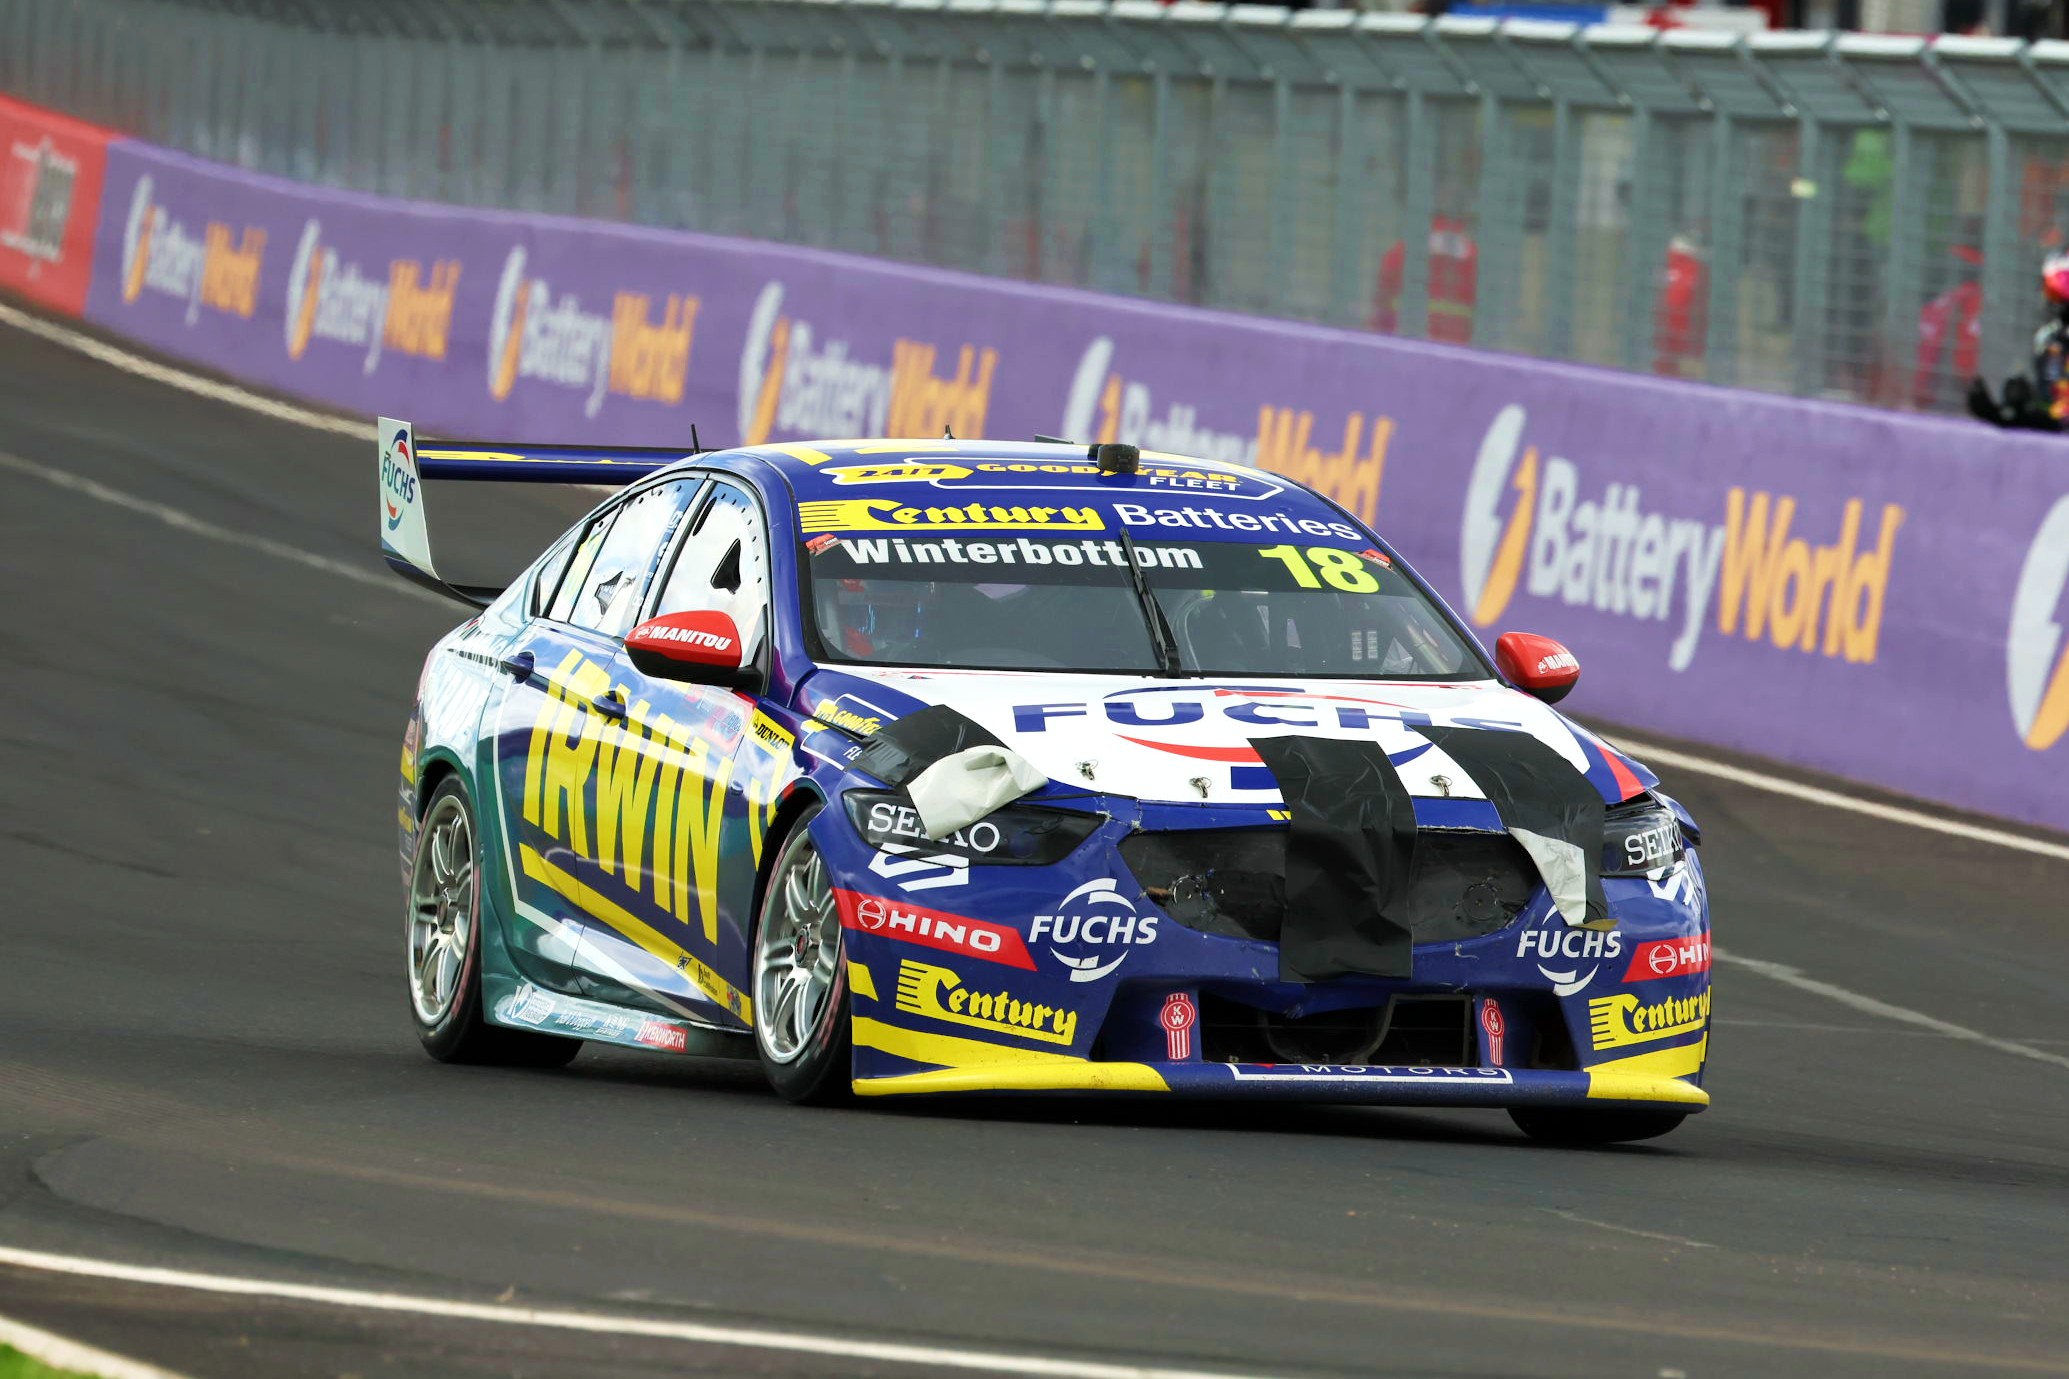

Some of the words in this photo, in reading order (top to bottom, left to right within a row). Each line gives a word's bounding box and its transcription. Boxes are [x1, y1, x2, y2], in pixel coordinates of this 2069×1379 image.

[381, 451, 416, 504] FUCHS
[1150, 476, 1240, 491] FLEET
[800, 499, 1105, 533] Century
[1112, 503, 1362, 541] Batteries
[840, 537, 1203, 569] Winterbottom
[1258, 544, 1380, 594] 18
[649, 626, 732, 651] MANITOU
[523, 648, 734, 946] IRWIN
[868, 802, 1000, 853] SEO
[888, 909, 1002, 953] HINO
[1028, 915, 1159, 945] FUCHS
[1516, 930, 1622, 959] FUCHS
[1679, 943, 1710, 965] HIN
[896, 958, 1078, 1046] Century
[1301, 1064, 1499, 1076] MOTORS
